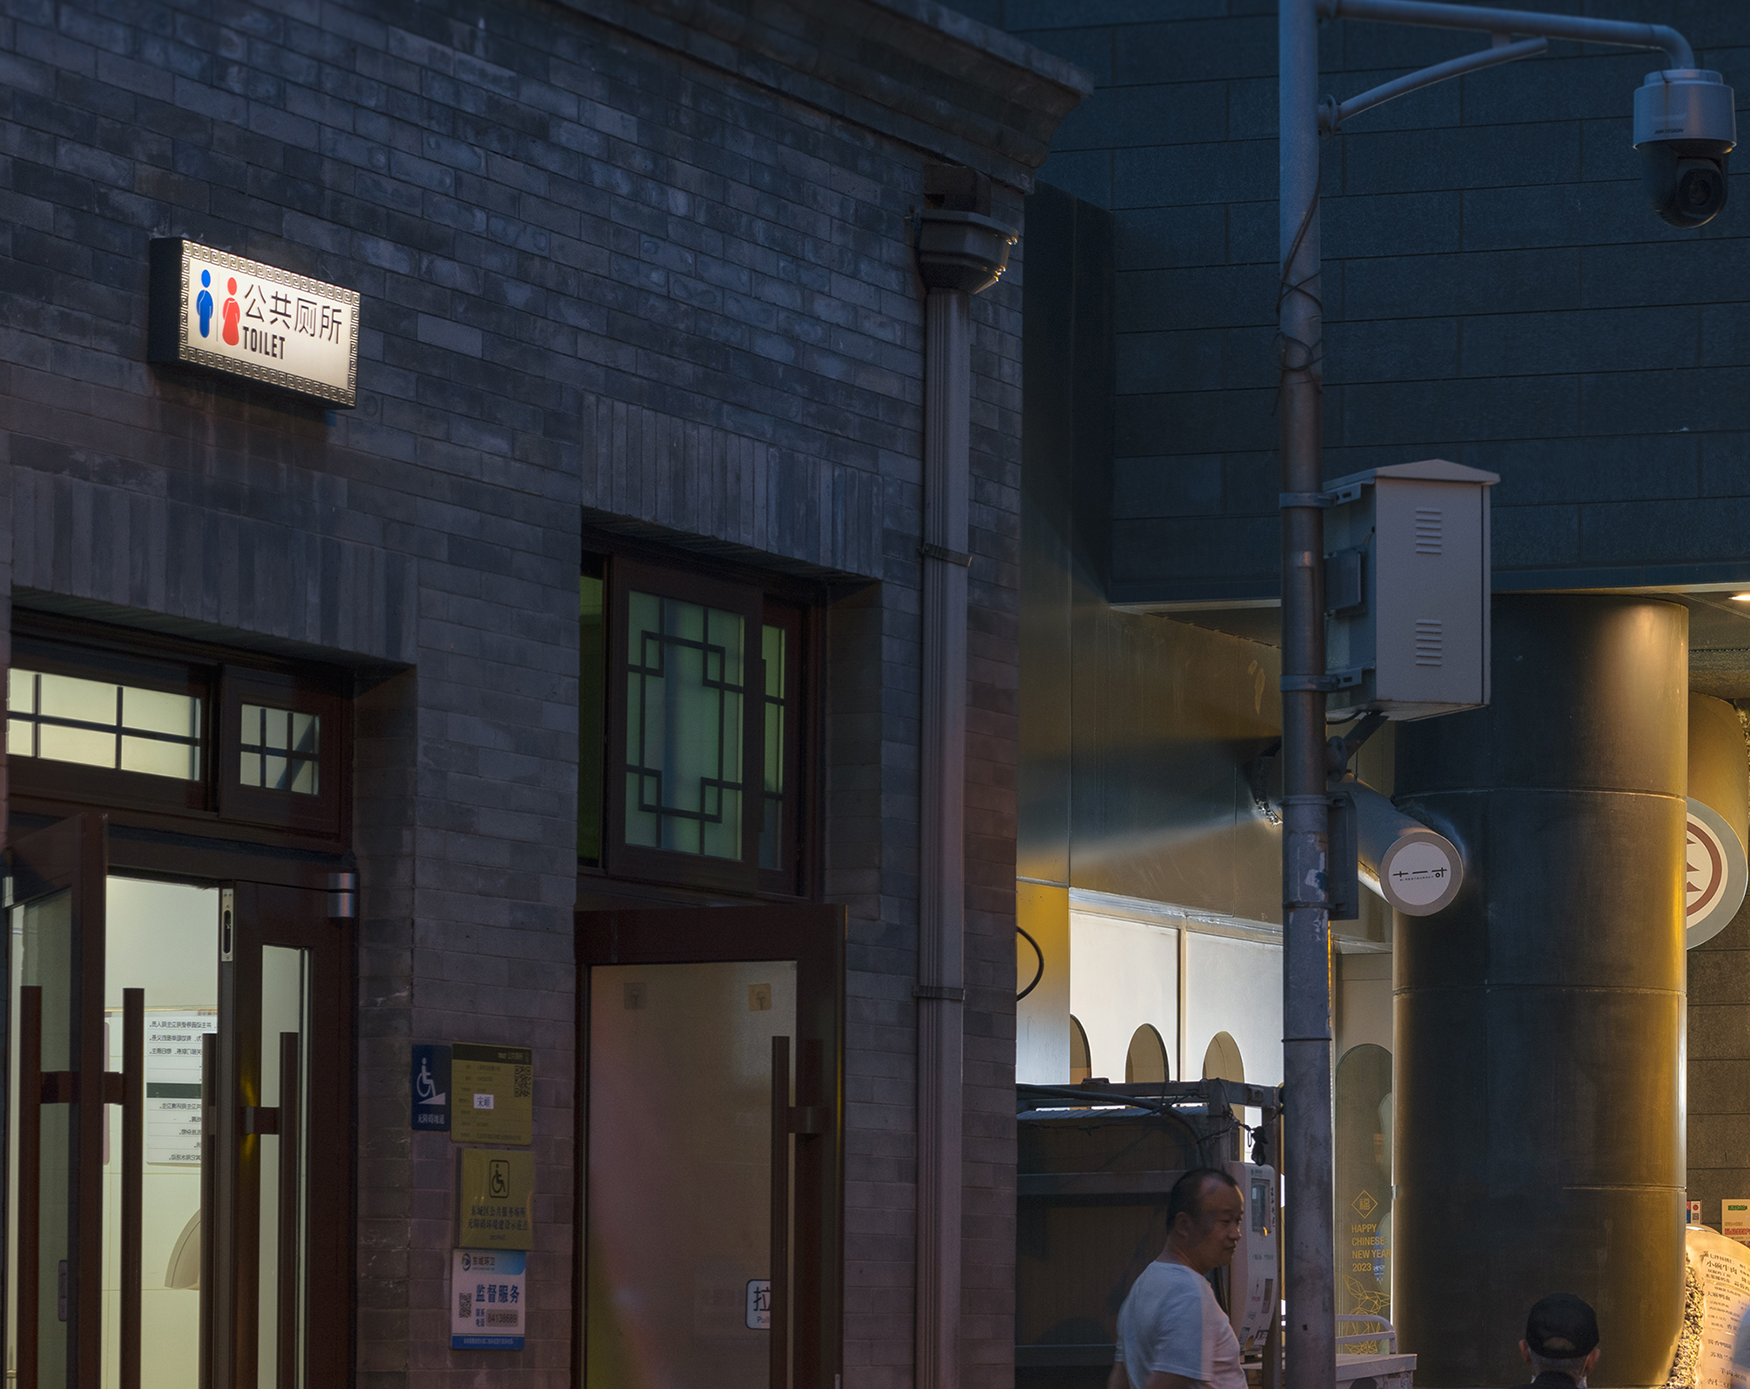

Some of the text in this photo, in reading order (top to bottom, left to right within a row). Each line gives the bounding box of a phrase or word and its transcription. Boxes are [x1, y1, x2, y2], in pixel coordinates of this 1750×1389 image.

[244, 284, 343, 344] 公共厕所
[243, 326, 286, 360] TOILET
[1351, 1224, 1377, 1233] HAPPY
[1351, 1236, 1385, 1246] CHINESE
[1352, 1249, 1391, 1259] NEW YEAR
[1352, 1262, 1372, 1272] 2023
[475, 1284, 519, 1303] 监督服务
